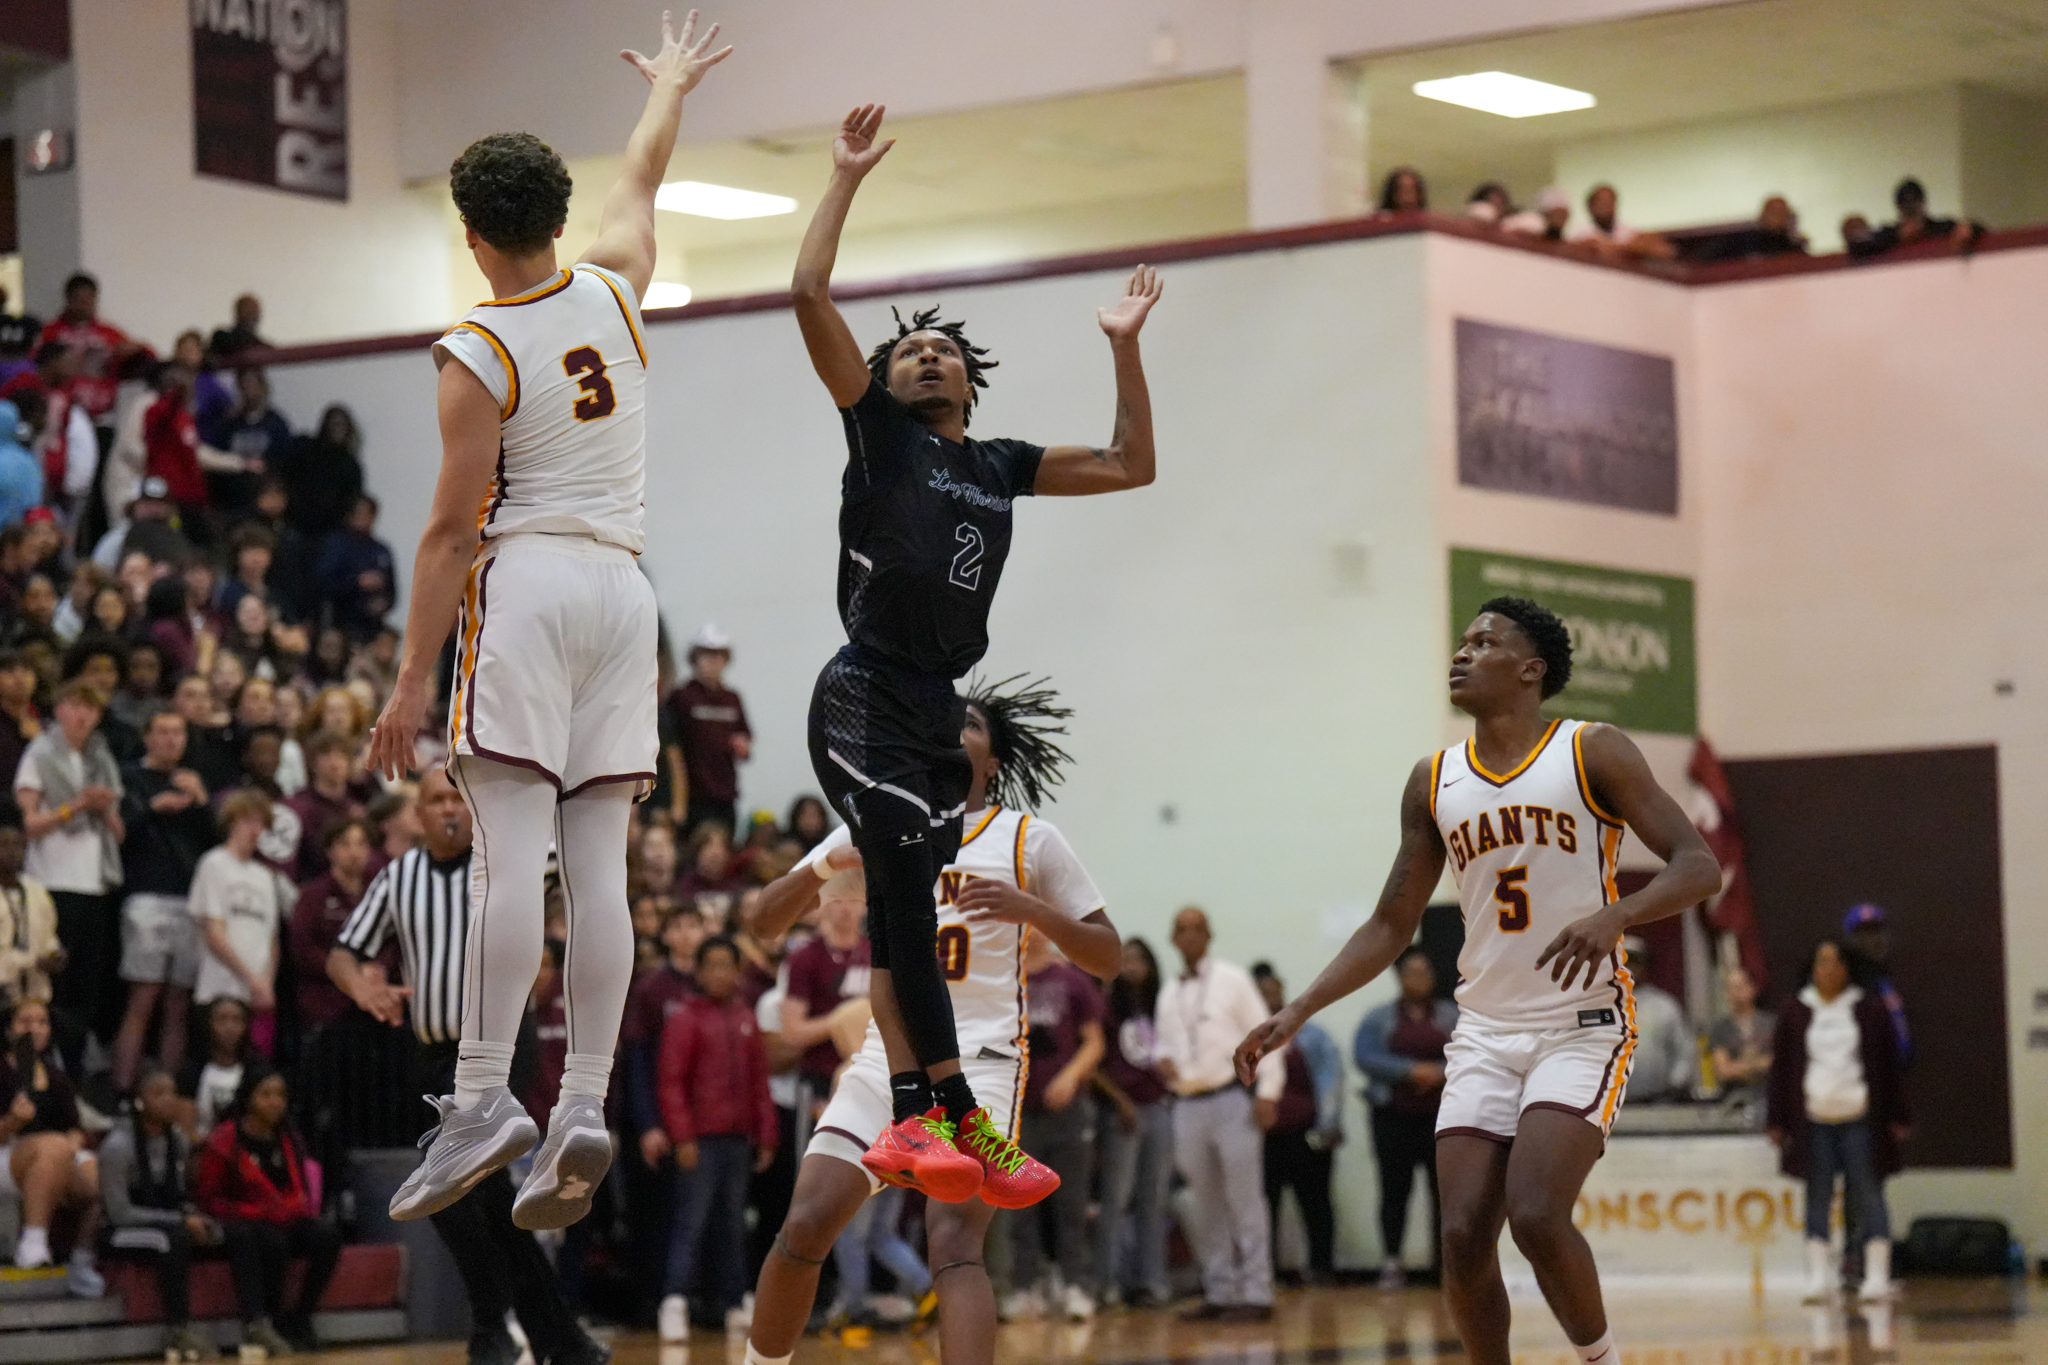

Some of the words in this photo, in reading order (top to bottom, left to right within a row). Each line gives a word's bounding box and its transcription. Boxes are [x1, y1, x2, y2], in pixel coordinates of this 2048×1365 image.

[562, 345, 617, 423] 3
[949, 521, 984, 591] 2
[1558, 615, 1669, 671] ONSON
[1449, 805, 1577, 872] GIANTS
[1494, 865, 1531, 933] 5
